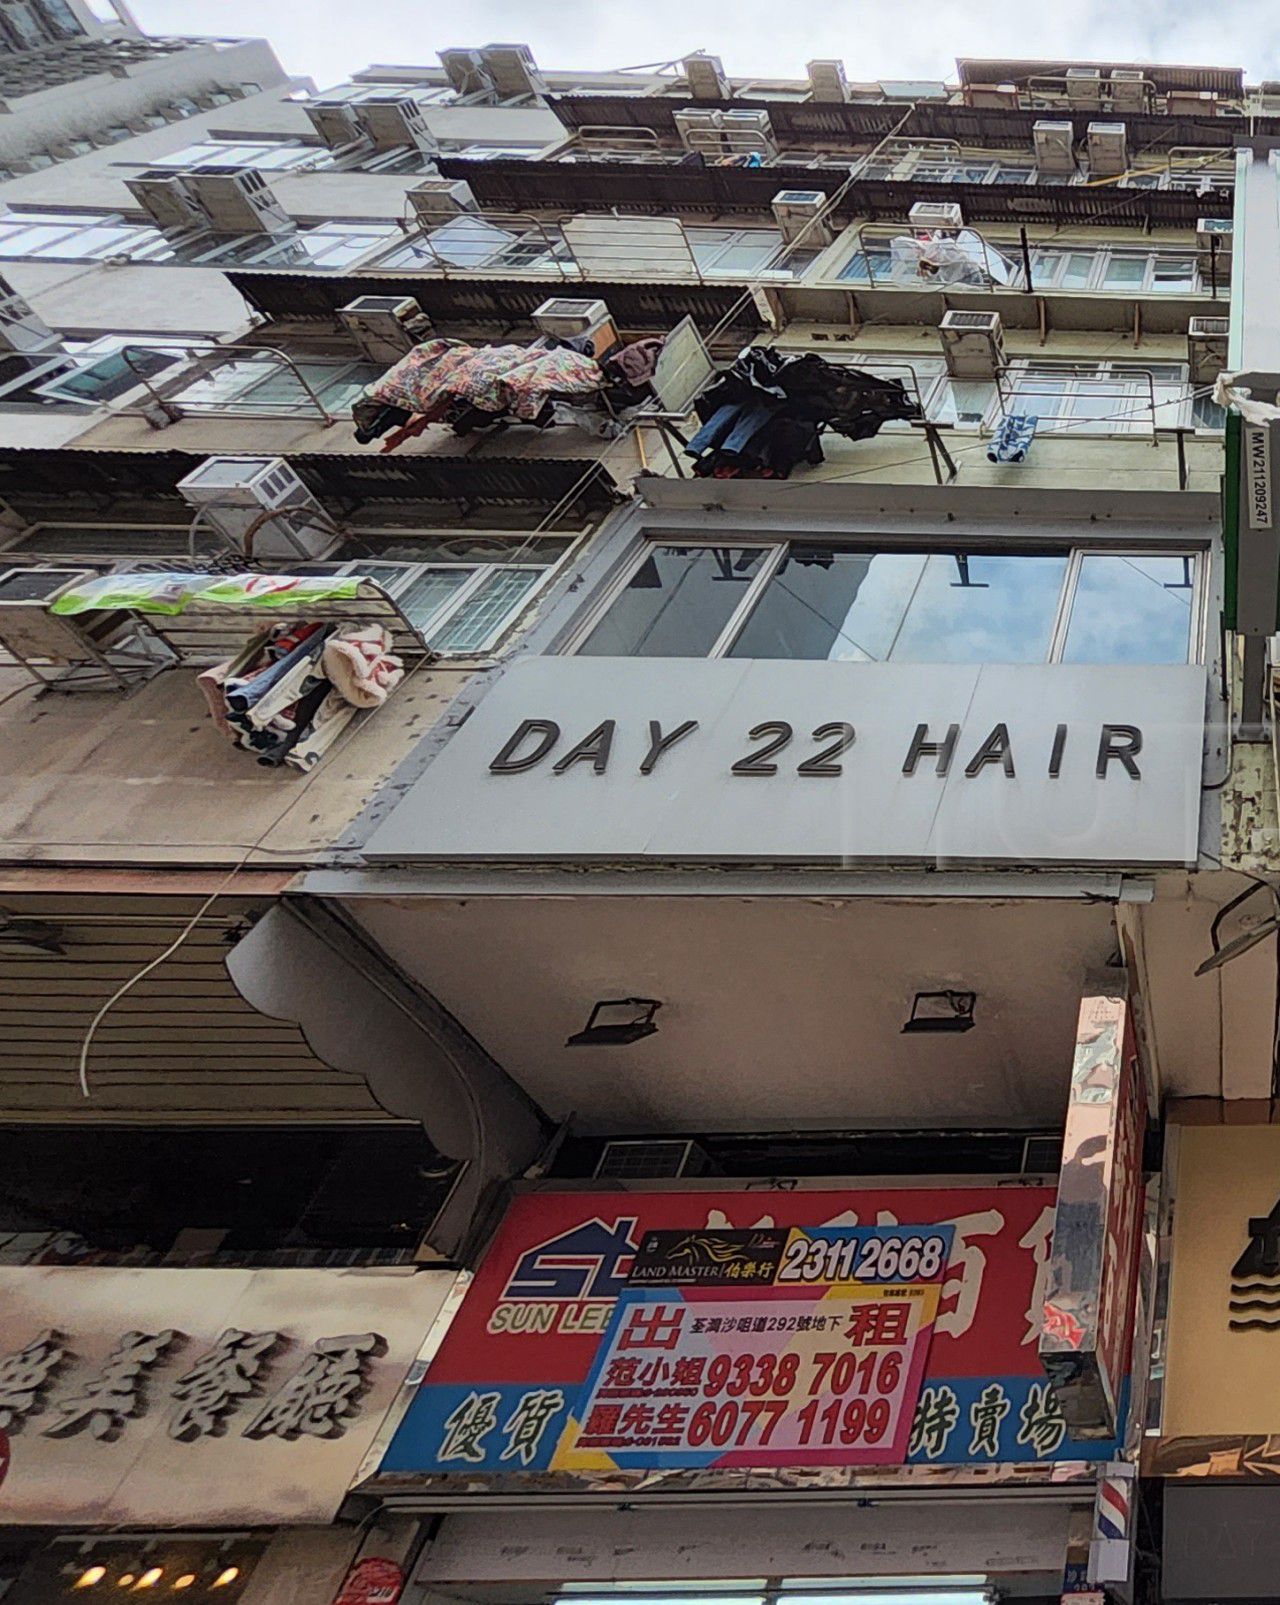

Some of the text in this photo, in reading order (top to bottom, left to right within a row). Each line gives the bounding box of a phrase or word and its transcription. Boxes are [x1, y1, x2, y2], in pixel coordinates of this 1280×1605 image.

[1251, 432, 1268, 524] MW211209247
[488, 718, 1143, 780] DAY 22 HAIR
[631, 1264, 719, 1278] LAND MASTER
[723, 1260, 775, 1279] 伯樂行
[779, 1235, 945, 1281] 2311 2668
[489, 1304, 558, 1333] SUN
[620, 1303, 912, 1350] 出 租
[602, 1351, 903, 1397] 范小姐 9338 7016
[438, 1390, 564, 1465] 優質
[583, 1398, 891, 1447] 羅先生 6077 1199
